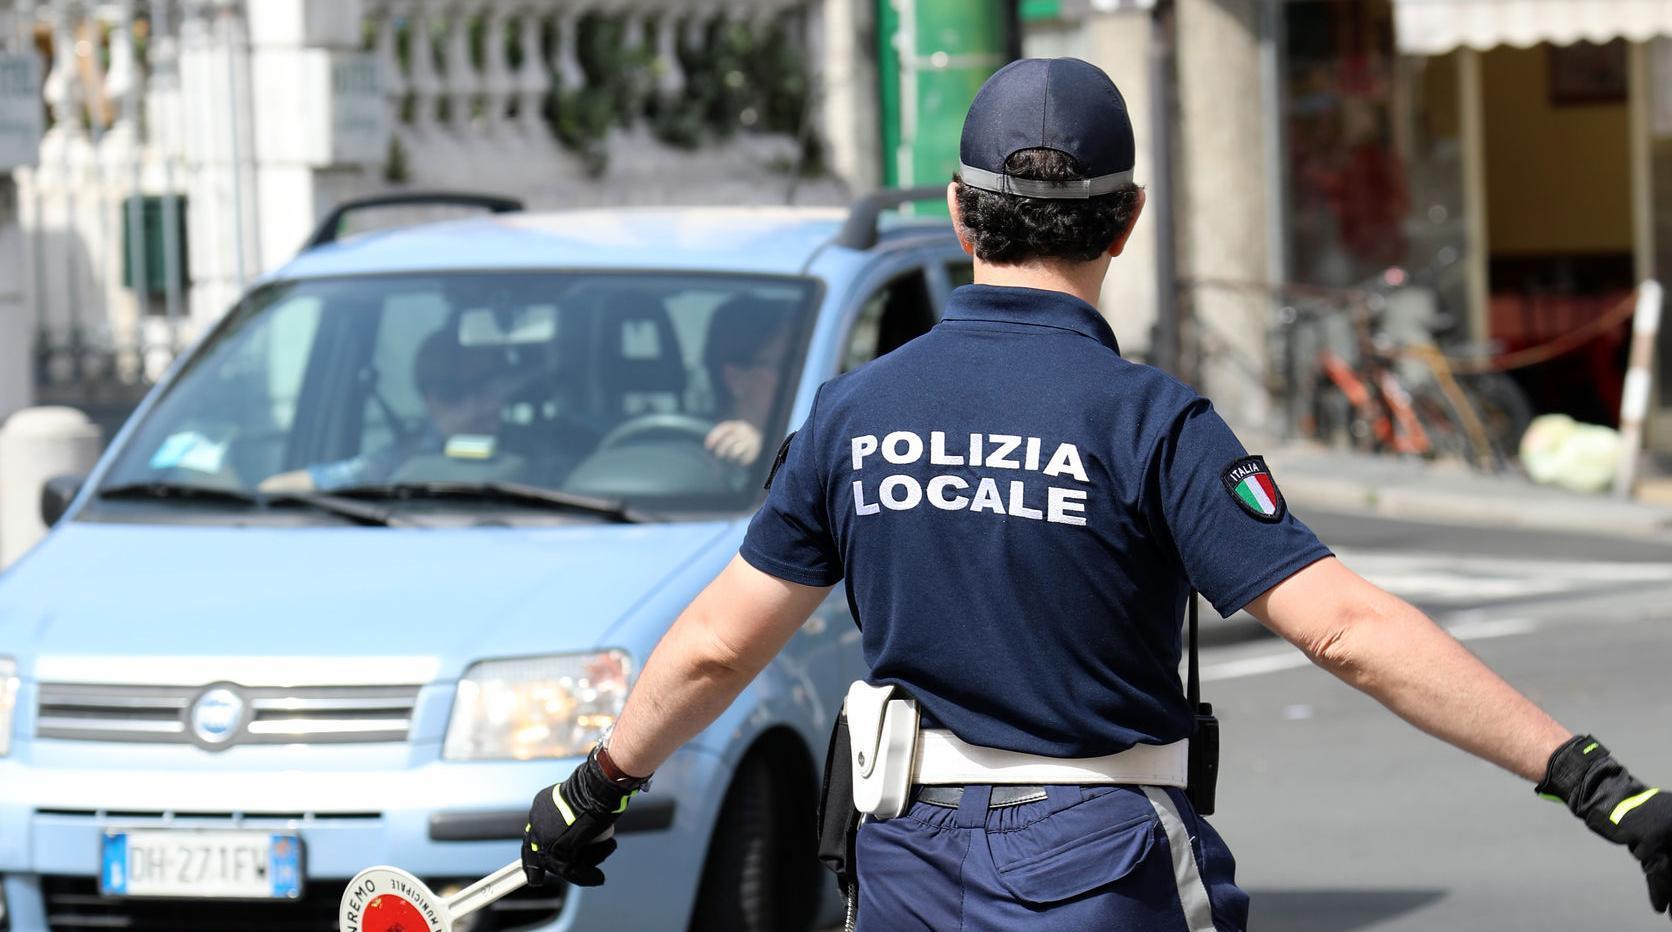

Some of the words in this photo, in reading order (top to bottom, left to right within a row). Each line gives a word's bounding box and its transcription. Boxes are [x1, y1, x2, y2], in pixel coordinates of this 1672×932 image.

[851, 431, 1090, 482] POLIZIA
[1230, 462, 1260, 482] ITALIA
[853, 474, 1088, 526] LOCALE
[391, 879, 439, 925] MUNICIPALE
